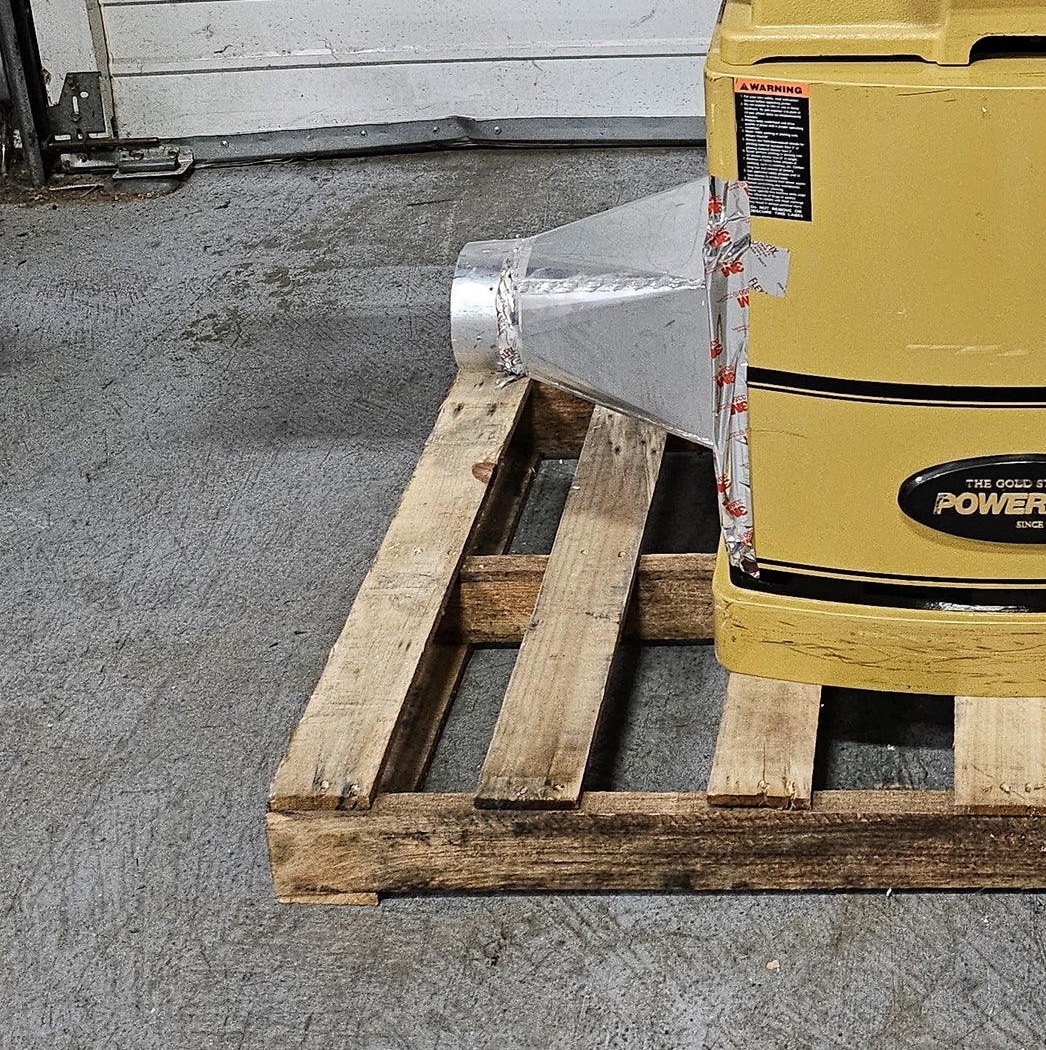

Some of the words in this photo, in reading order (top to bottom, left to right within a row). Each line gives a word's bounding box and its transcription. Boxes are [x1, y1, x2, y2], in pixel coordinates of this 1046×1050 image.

[750, 83, 803, 95] WARNING
[966, 479, 992, 489] THE
[995, 479, 1033, 489] GOLD
[1016, 520, 1044, 529] SINCE
